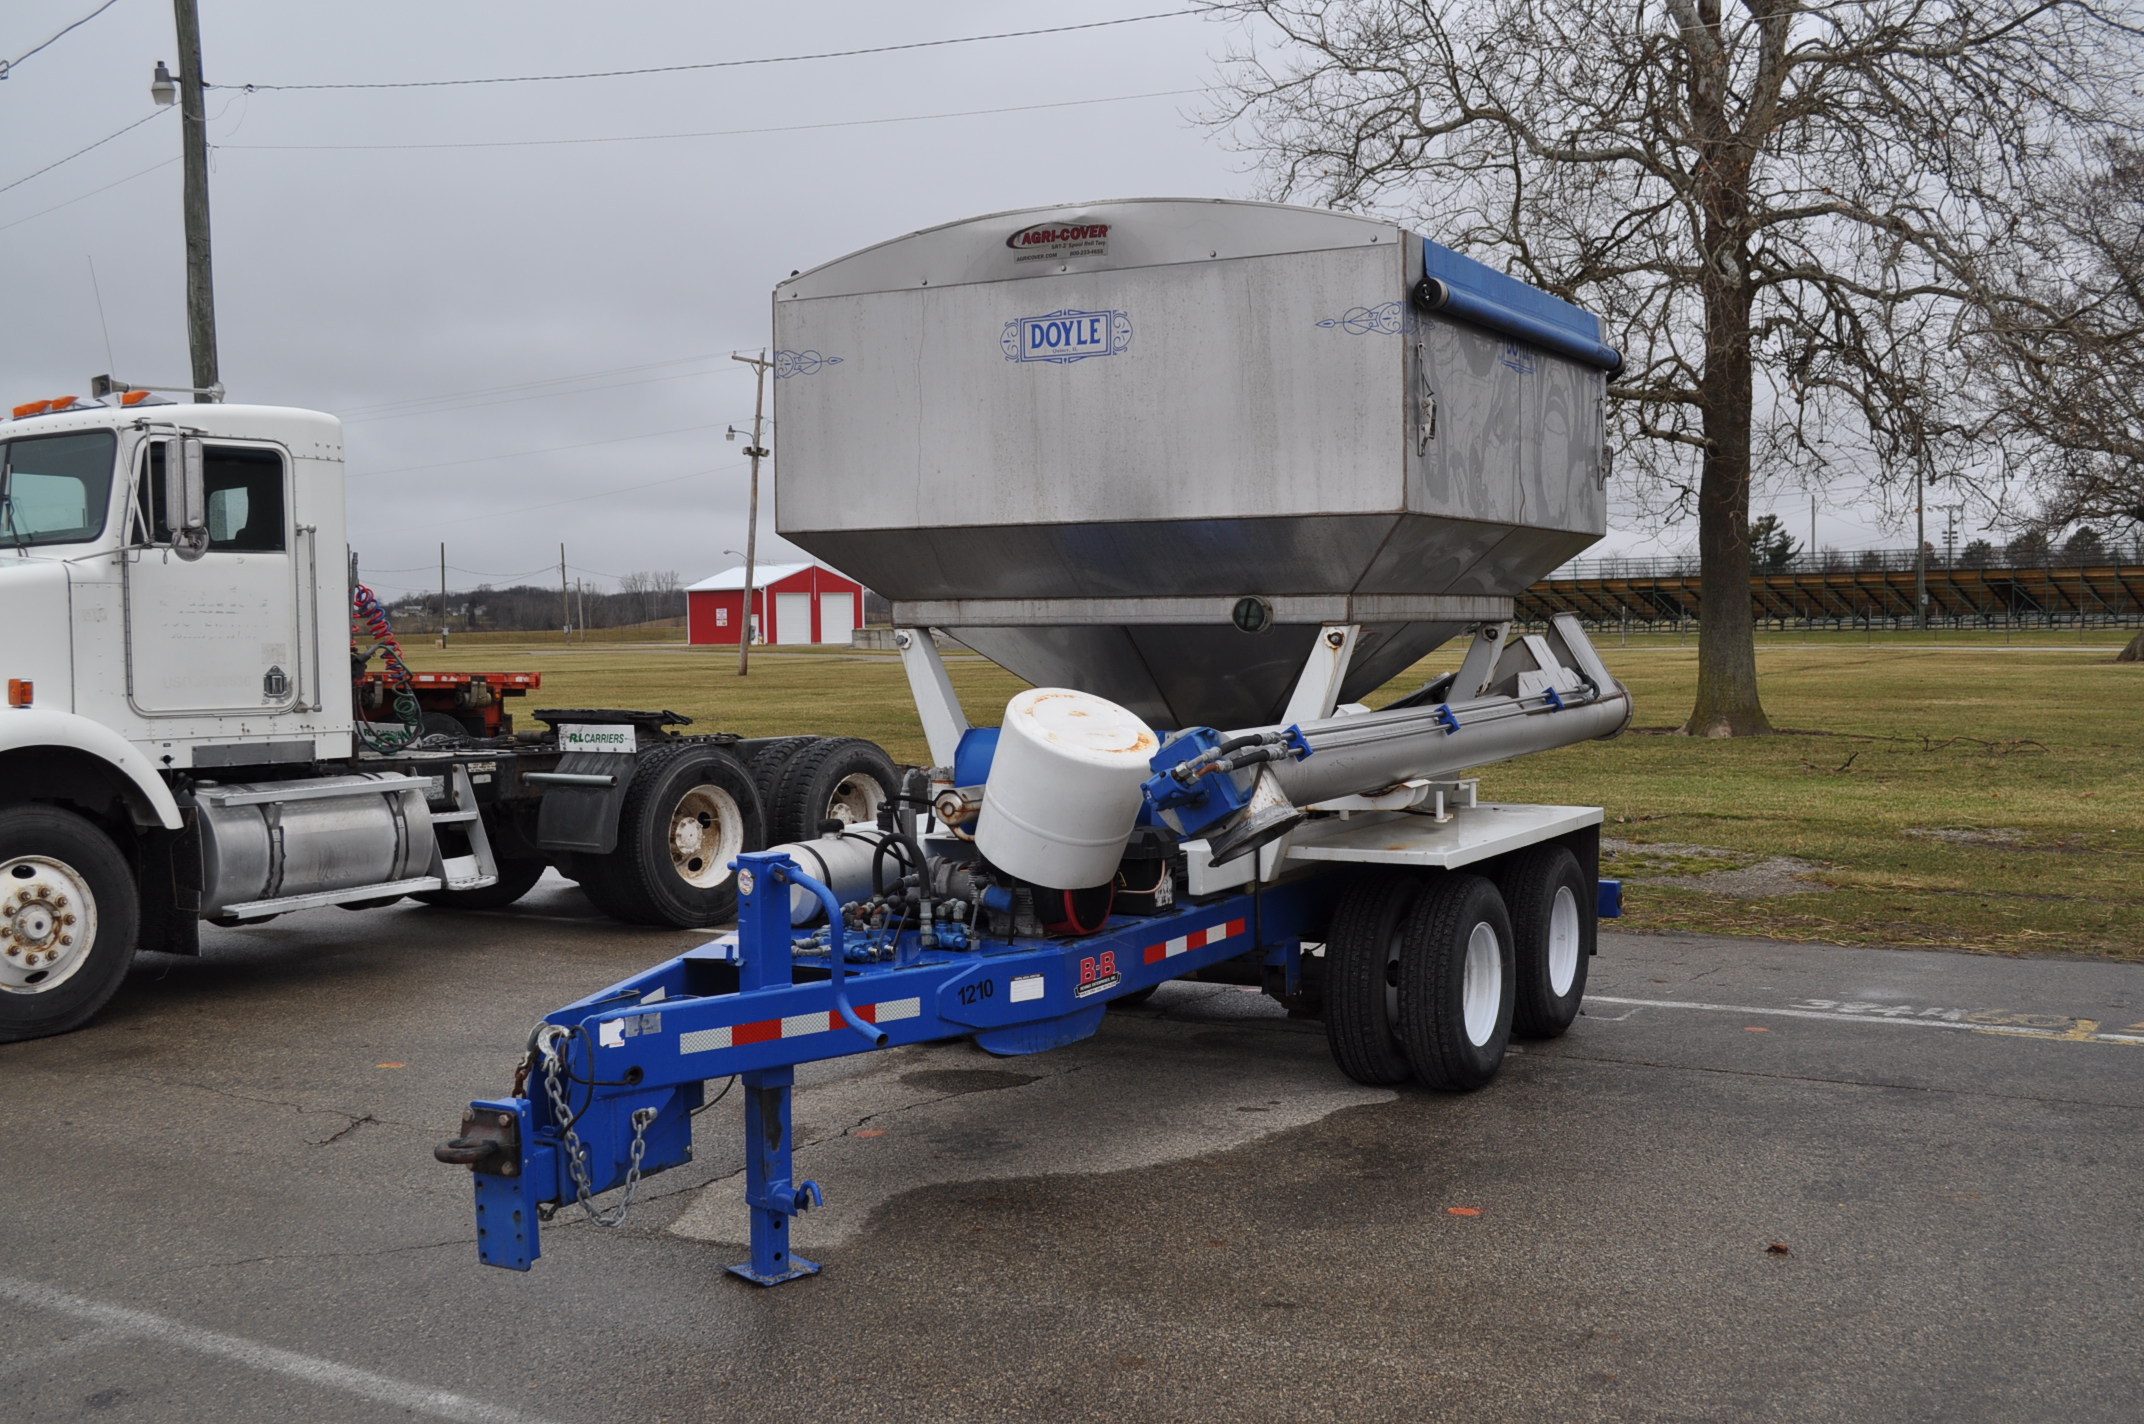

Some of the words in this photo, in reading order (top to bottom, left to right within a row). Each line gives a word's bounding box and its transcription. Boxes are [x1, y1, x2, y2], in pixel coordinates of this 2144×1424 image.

[1031, 318, 1101, 349] DOYLE
[584, 733, 625, 744] CARRIERS
[1080, 950, 1116, 985] B-B
[958, 978, 994, 1005] 1210
